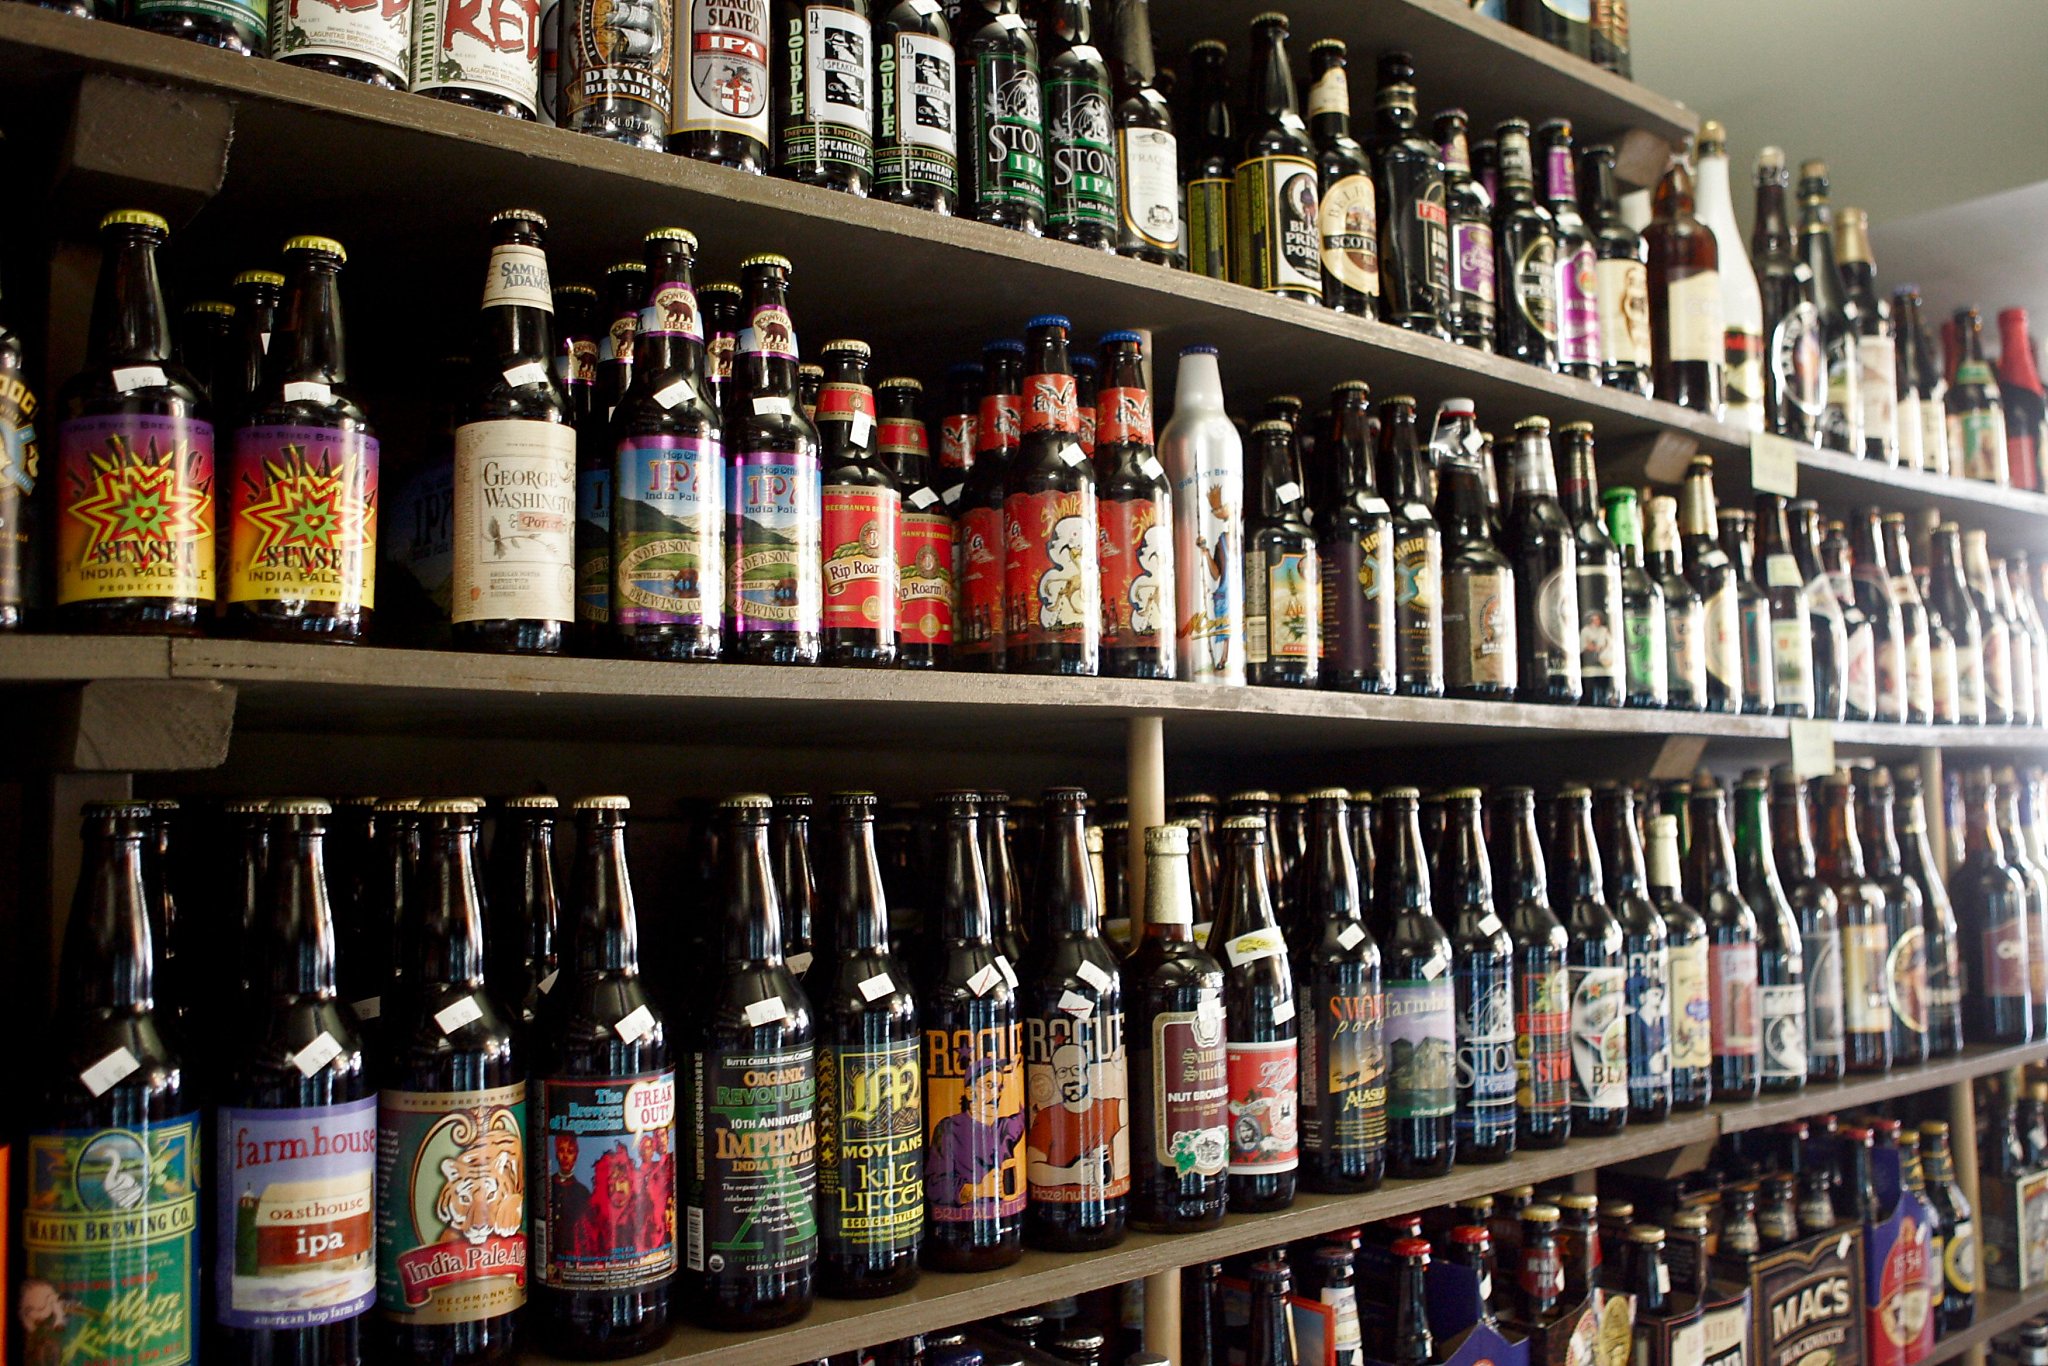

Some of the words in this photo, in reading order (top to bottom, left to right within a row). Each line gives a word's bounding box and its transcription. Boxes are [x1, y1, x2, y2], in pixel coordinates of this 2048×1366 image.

[707, 9, 760, 36] SLAYER
[709, 36, 759, 58] IPA
[789, 19, 805, 116] DOUBLE
[585, 82, 651, 98] BLONDE
[880, 44, 896, 137] DOUBLE
[833, 126, 860, 141] INDIA
[819, 139, 866, 157] SPEAKEASY
[909, 160, 953, 178] SPEAKEASY
[1079, 175, 1114, 198] IPA
[663, 320, 693, 332] BEER
[616, 349, 633, 359] BE
[761, 341, 789, 352] BEER
[484, 461, 558, 489] GEORGE
[645, 491, 675, 501] India
[744, 505, 774, 514] India
[521, 514, 563, 530] Porter
[97, 539, 194, 565] SUNSET
[265, 545, 358, 572] SUNSET
[628, 539, 692, 567] ANDERSON
[80, 566, 127, 581] INDIA
[133, 566, 175, 580] PALE
[249, 571, 294, 583] INDIA
[300, 571, 341, 584] PALE
[830, 561, 850, 580] Rip
[629, 586, 684, 612] BREWING
[732, 597, 785, 619] BREWING
[926, 1021, 1024, 1077] ROGUE
[1025, 1013, 1126, 1063] ROGUE
[726, 1058, 747, 1067] BUTTE
[748, 1056, 769, 1066] CREEK
[1455, 1045, 1510, 1089] STO
[743, 1065, 806, 1087] ORGANIC
[595, 1088, 623, 1105] The
[634, 1084, 673, 1108] FREAK
[717, 1077, 816, 1105] REVOLUTION
[1168, 1091, 1192, 1103] NUT
[1192, 1085, 1221, 1102] BROWN
[569, 1102, 623, 1119] Brewers
[641, 1104, 670, 1125] OUT!
[731, 1119, 756, 1130] 10TH
[758, 1109, 813, 1128] ANNIVERSARY
[235, 1126, 378, 1169] farmhouse
[715, 1120, 817, 1159] IMPERIAL
[842, 1134, 923, 1160] MOYLANS
[732, 1159, 769, 1173] INDIA
[771, 1154, 798, 1170] PALE
[799, 1149, 813, 1164] ALE
[721, 1183, 734, 1191] The
[735, 1183, 759, 1192] organic
[836, 1179, 924, 1217] LIFTER
[1032, 1186, 1088, 1202] Hazelnut
[1088, 1182, 1121, 1200] Brown
[269, 1194, 365, 1221] oasthouse
[762, 1202, 787, 1213] Organic
[933, 1199, 992, 1220] BRUTAL
[29, 1220, 79, 1242] MARIN
[85, 1213, 168, 1241] BREWING
[295, 1229, 346, 1258] ipa
[405, 1252, 464, 1284] India
[466, 1244, 506, 1271] Pale
[506, 1240, 526, 1266] Ale
[729, 1254, 768, 1263] LIMITED
[774, 1254, 810, 1269] CALIFORNIA
[437, 1286, 514, 1306] BEERMANN'S
[253, 1309, 305, 1326] american
[307, 1310, 329, 1325] hop
[330, 1304, 355, 1318] farm
[1772, 1276, 1849, 1344] MAC'S
